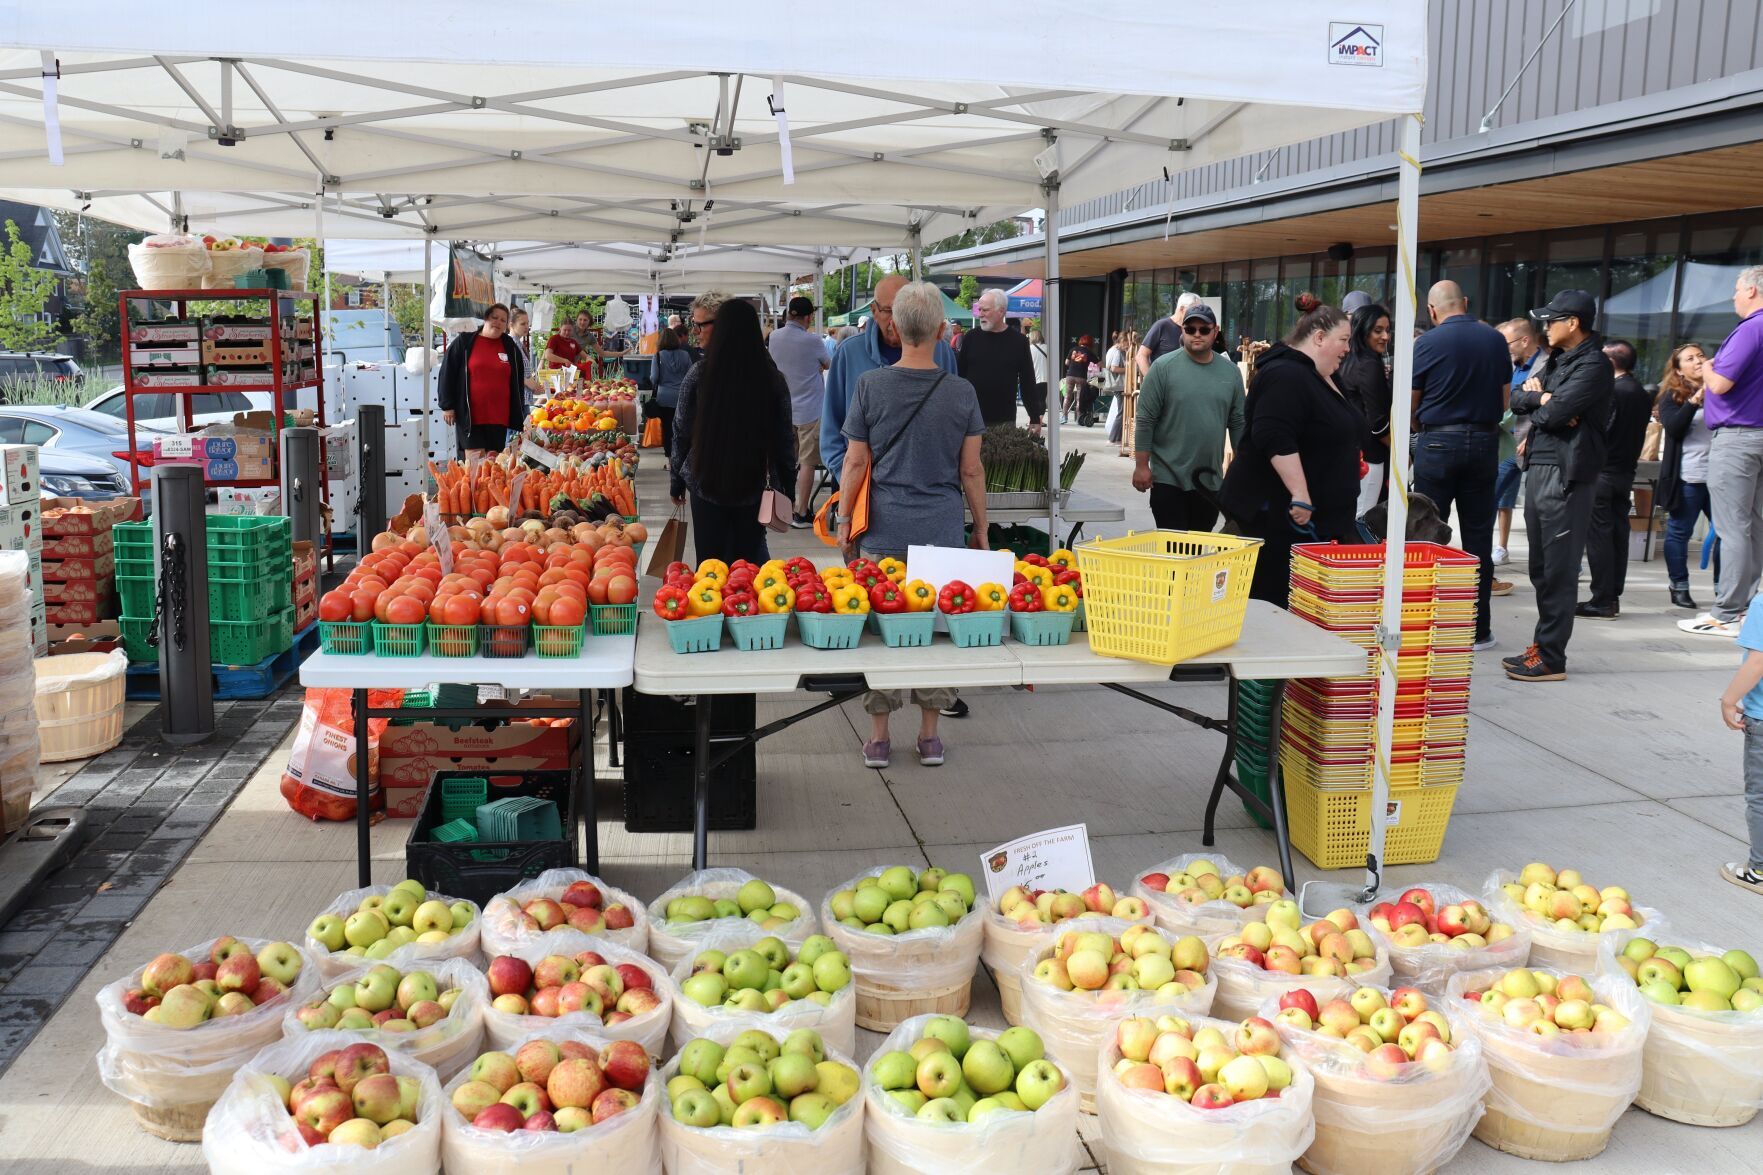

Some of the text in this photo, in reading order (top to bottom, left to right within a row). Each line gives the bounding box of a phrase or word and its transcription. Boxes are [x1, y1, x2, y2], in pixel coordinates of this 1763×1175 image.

[212, 441, 233, 449] pure
[325, 730, 348, 743] FINEST
[454, 737, 494, 745] Beefsteak
[323, 738, 348, 751] ONIONS
[1013, 845, 1031, 854] FRESH
[1031, 841, 1042, 849] OFF
[1017, 860, 1049, 877] Apples
